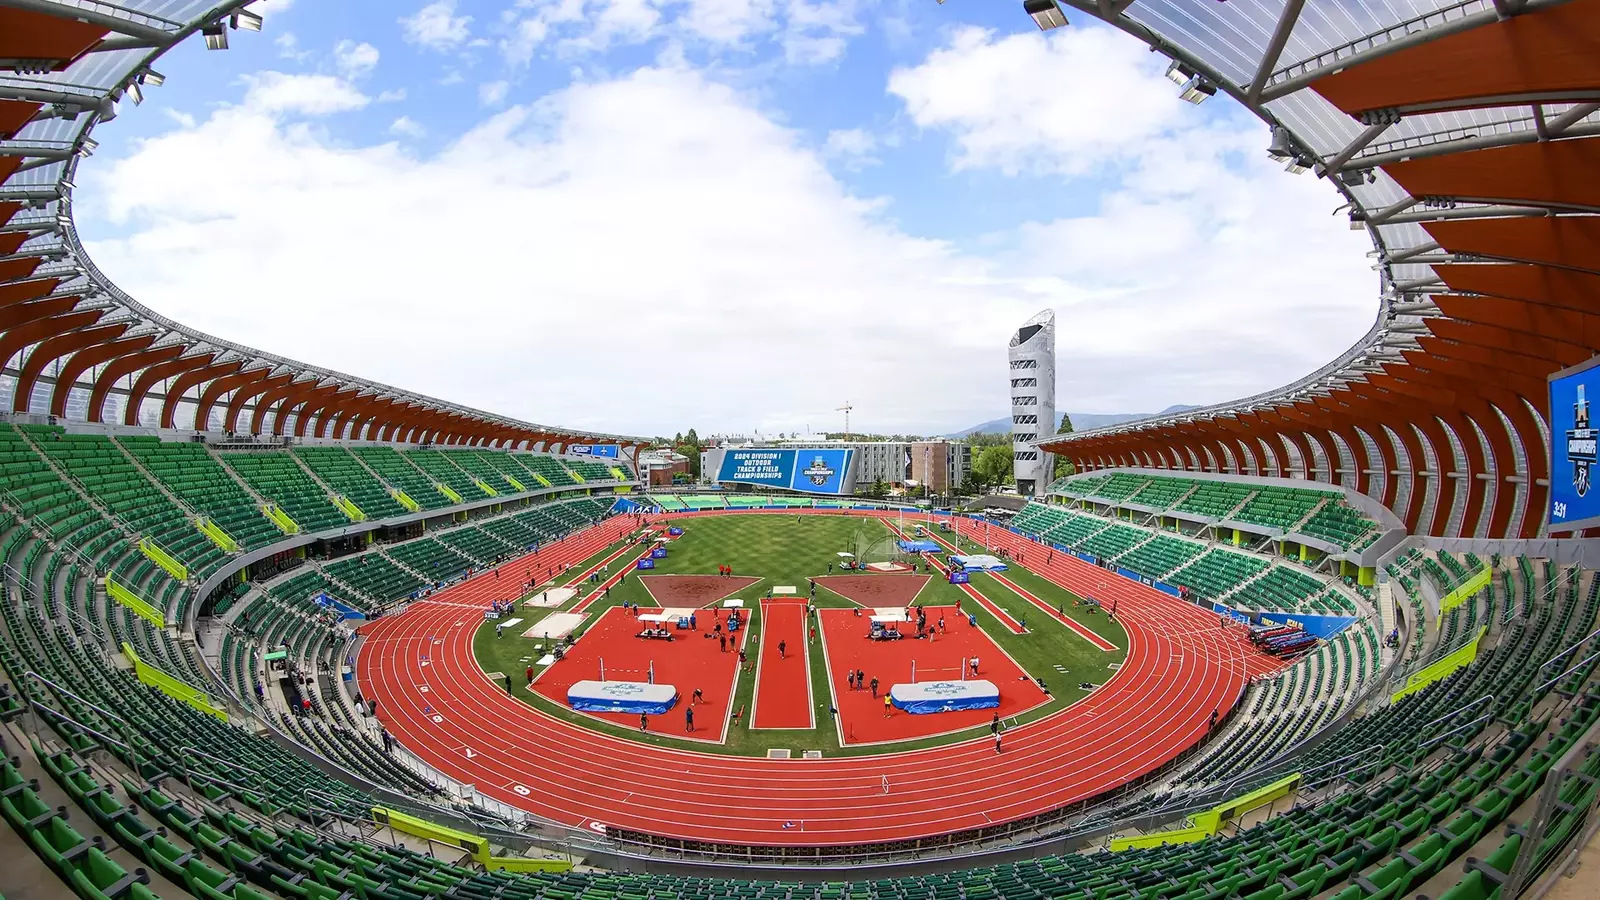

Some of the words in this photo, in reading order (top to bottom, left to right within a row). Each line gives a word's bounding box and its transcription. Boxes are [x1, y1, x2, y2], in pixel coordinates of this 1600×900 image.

[1553, 501, 1566, 518] 3:31
[466, 748, 477, 758] 7
[513, 784, 531, 796] 8
